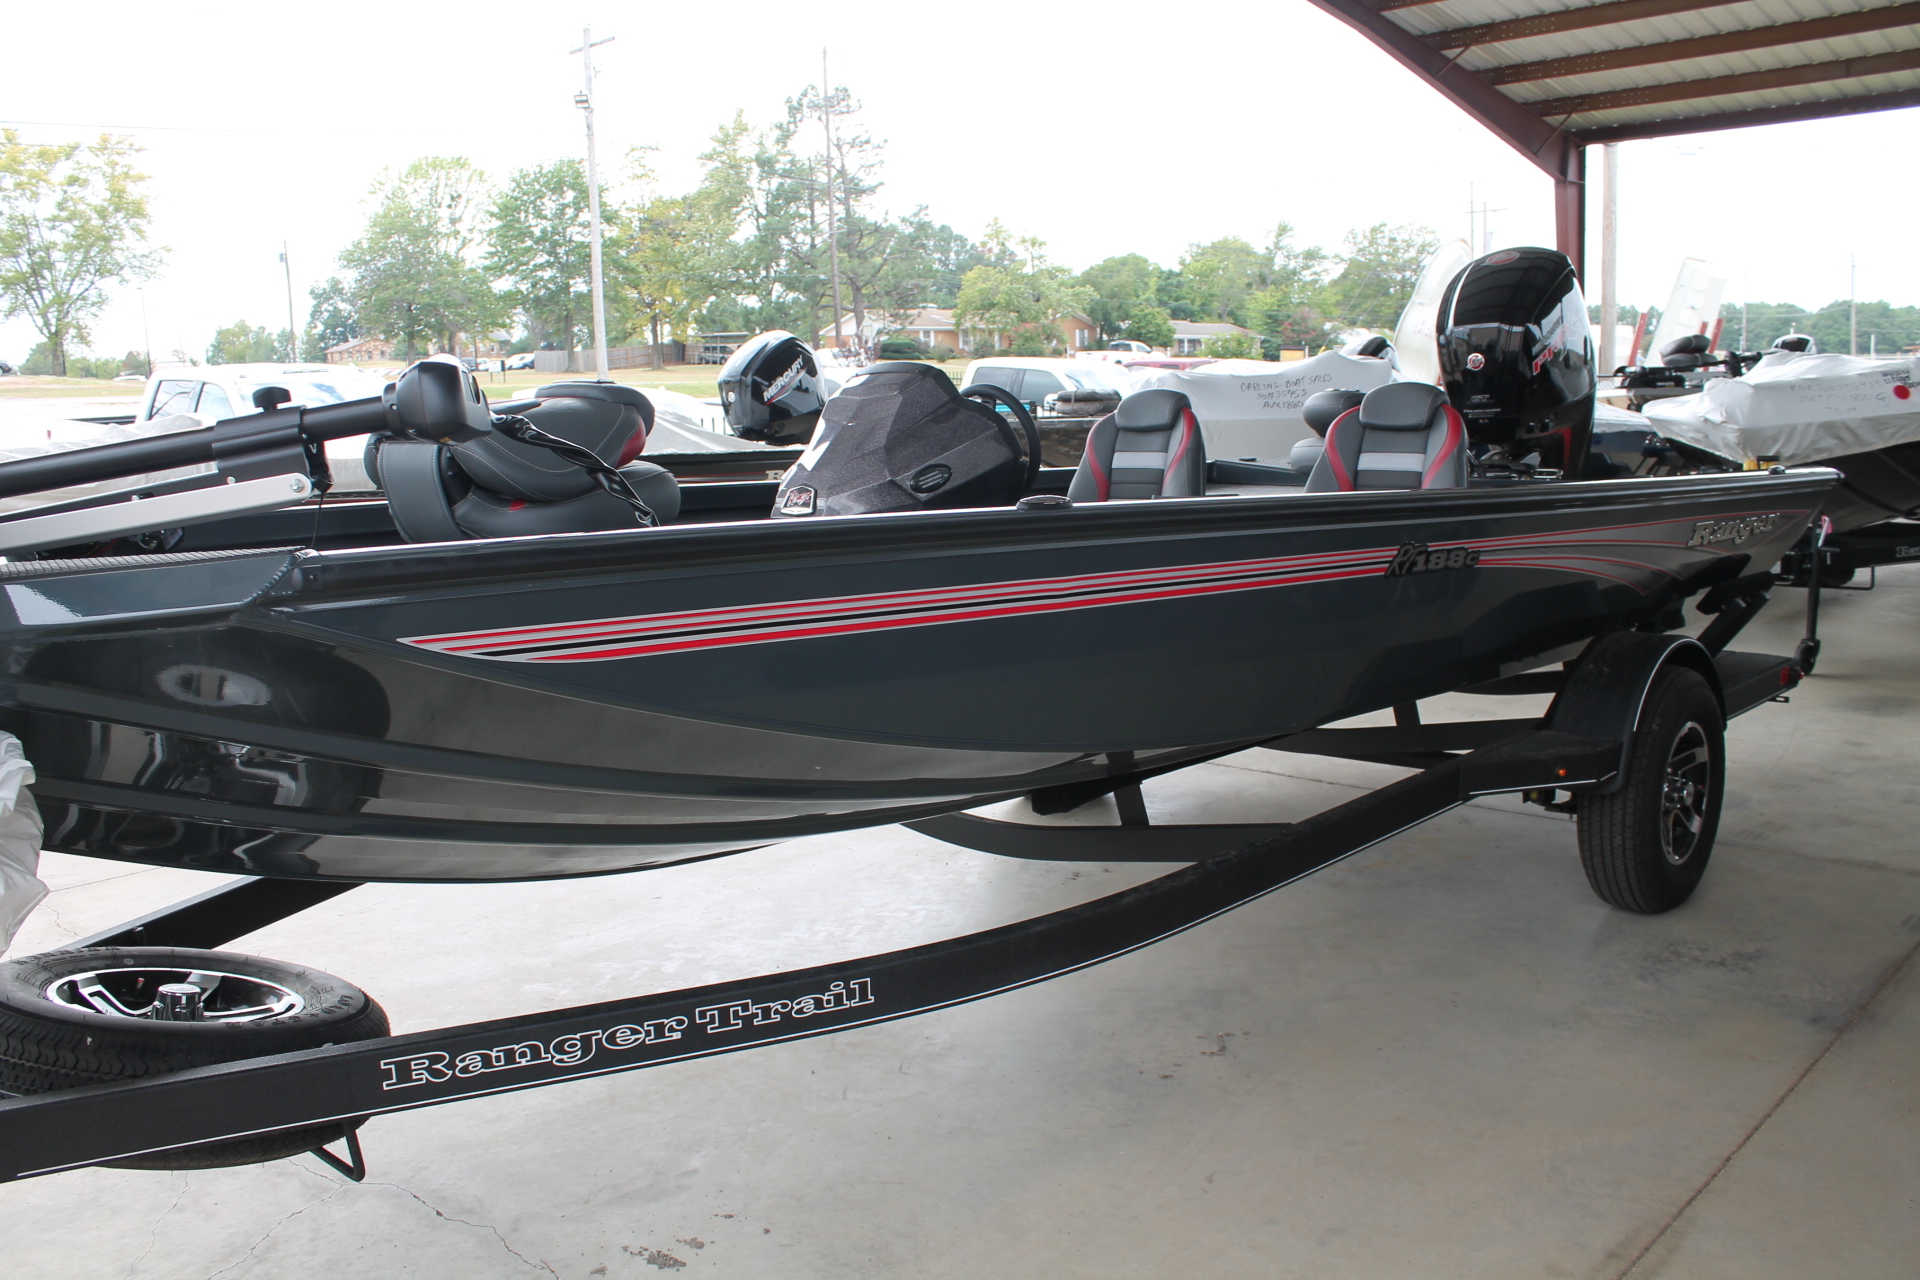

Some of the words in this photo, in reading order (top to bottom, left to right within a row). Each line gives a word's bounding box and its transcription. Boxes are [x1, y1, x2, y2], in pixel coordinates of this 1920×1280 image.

[763, 354, 804, 402] MERCURY
[1285, 375, 1306, 388] BOAT
[1308, 373, 1333, 384] SALES
[1687, 513, 1780, 547] Ranger
[380, 1014, 689, 1090] Ranger
[695, 977, 875, 1034] Trail
